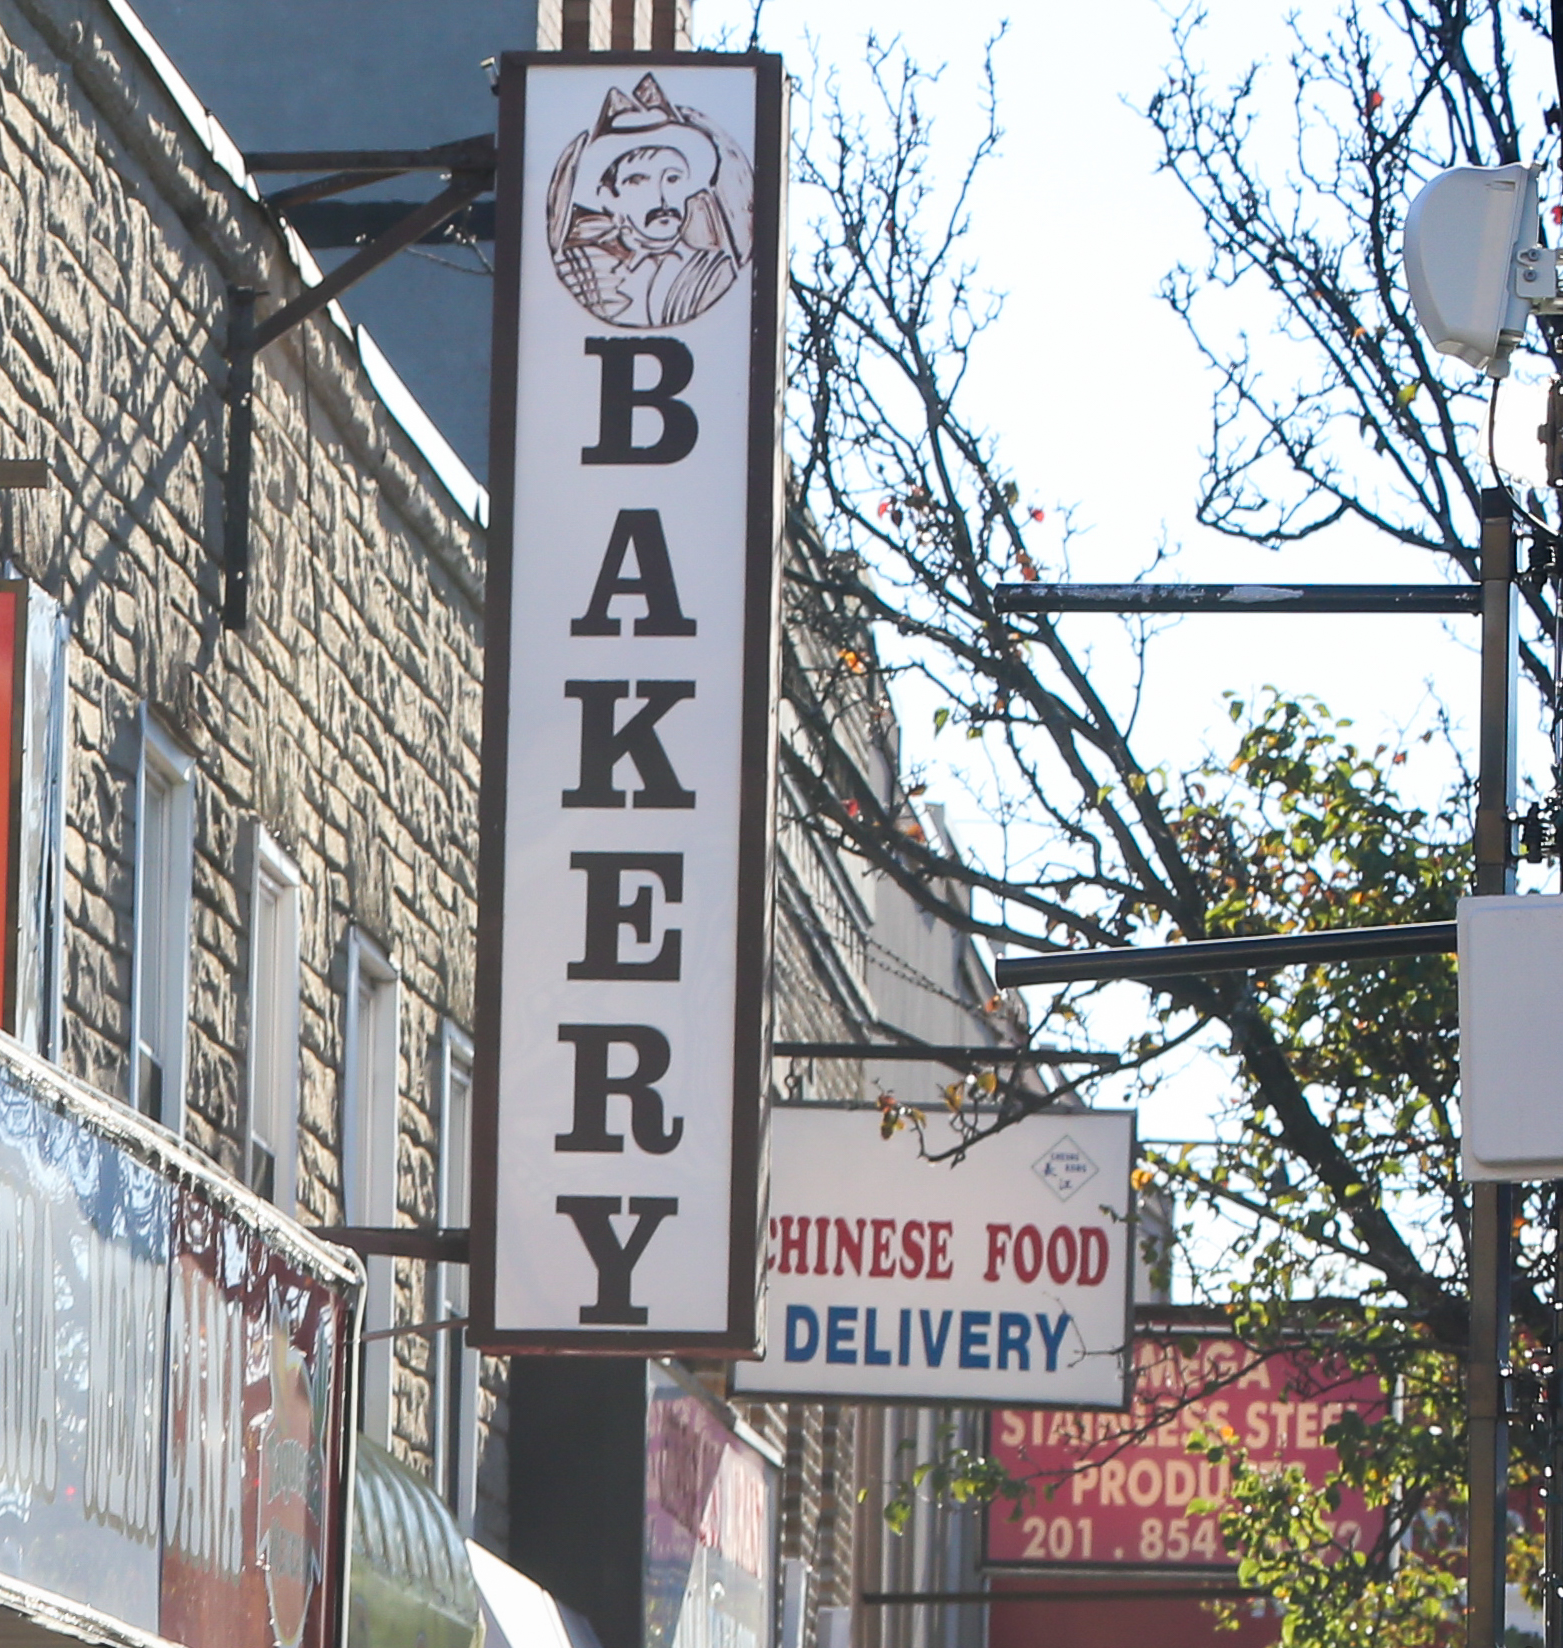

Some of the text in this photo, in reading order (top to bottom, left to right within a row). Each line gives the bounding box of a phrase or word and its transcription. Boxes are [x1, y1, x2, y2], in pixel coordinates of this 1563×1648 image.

[554, 336, 704, 1325] BAKERY
[769, 1215, 1110, 1287] HINESE FOOD
[784, 1304, 1072, 1373] DELIVERY
[1135, 1342, 1271, 1390] MEGA
[84, 1228, 244, 1587] MEXICANA
[1245, 1401, 1360, 1450] STEE
[1023, 1517, 1093, 1561] 201
[1139, 1518, 1217, 1561] 854
